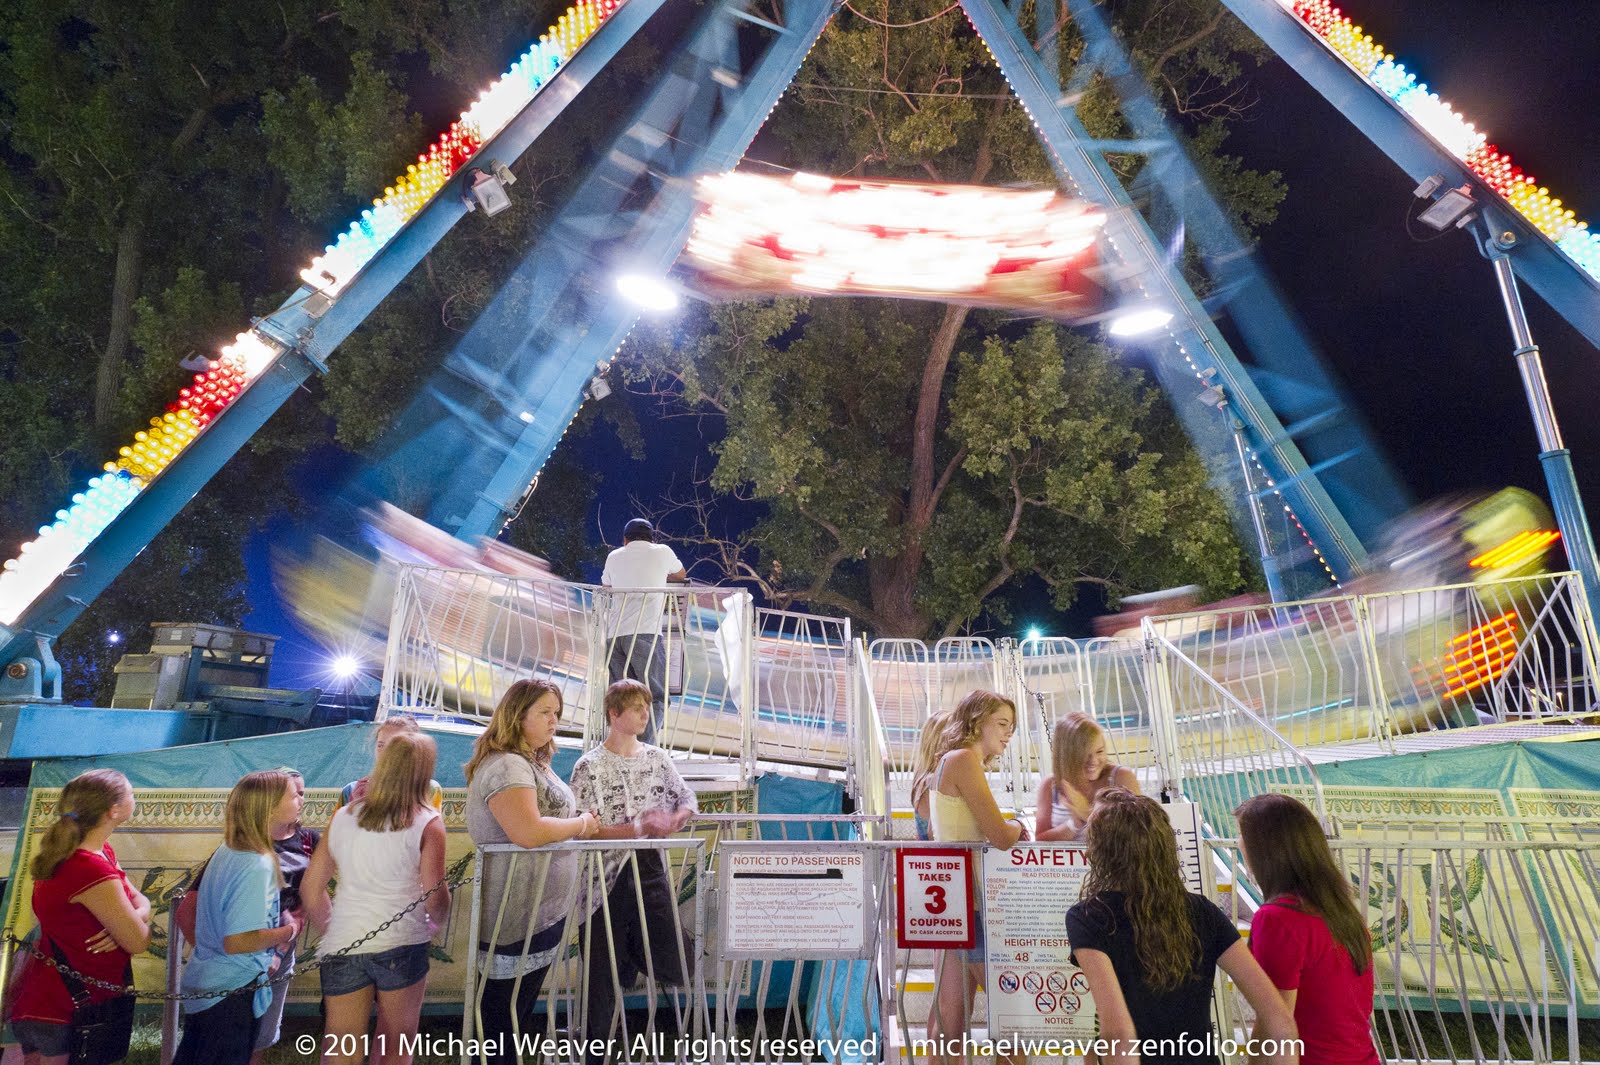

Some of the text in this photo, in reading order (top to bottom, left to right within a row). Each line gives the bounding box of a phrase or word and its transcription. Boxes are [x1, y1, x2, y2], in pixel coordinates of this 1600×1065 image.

[734, 857, 861, 865] NOTICE TO PASSENGERS
[1011, 849, 1088, 866] SAFETY
[908, 862, 961, 870] THIS RIDE
[918, 873, 952, 882] TAKES
[924, 885, 947, 915] 3
[909, 918, 963, 927] COUPONS
[1004, 938, 1071, 947] HEIGHT RESTR
[1044, 1017, 1074, 1025] NOTICE
